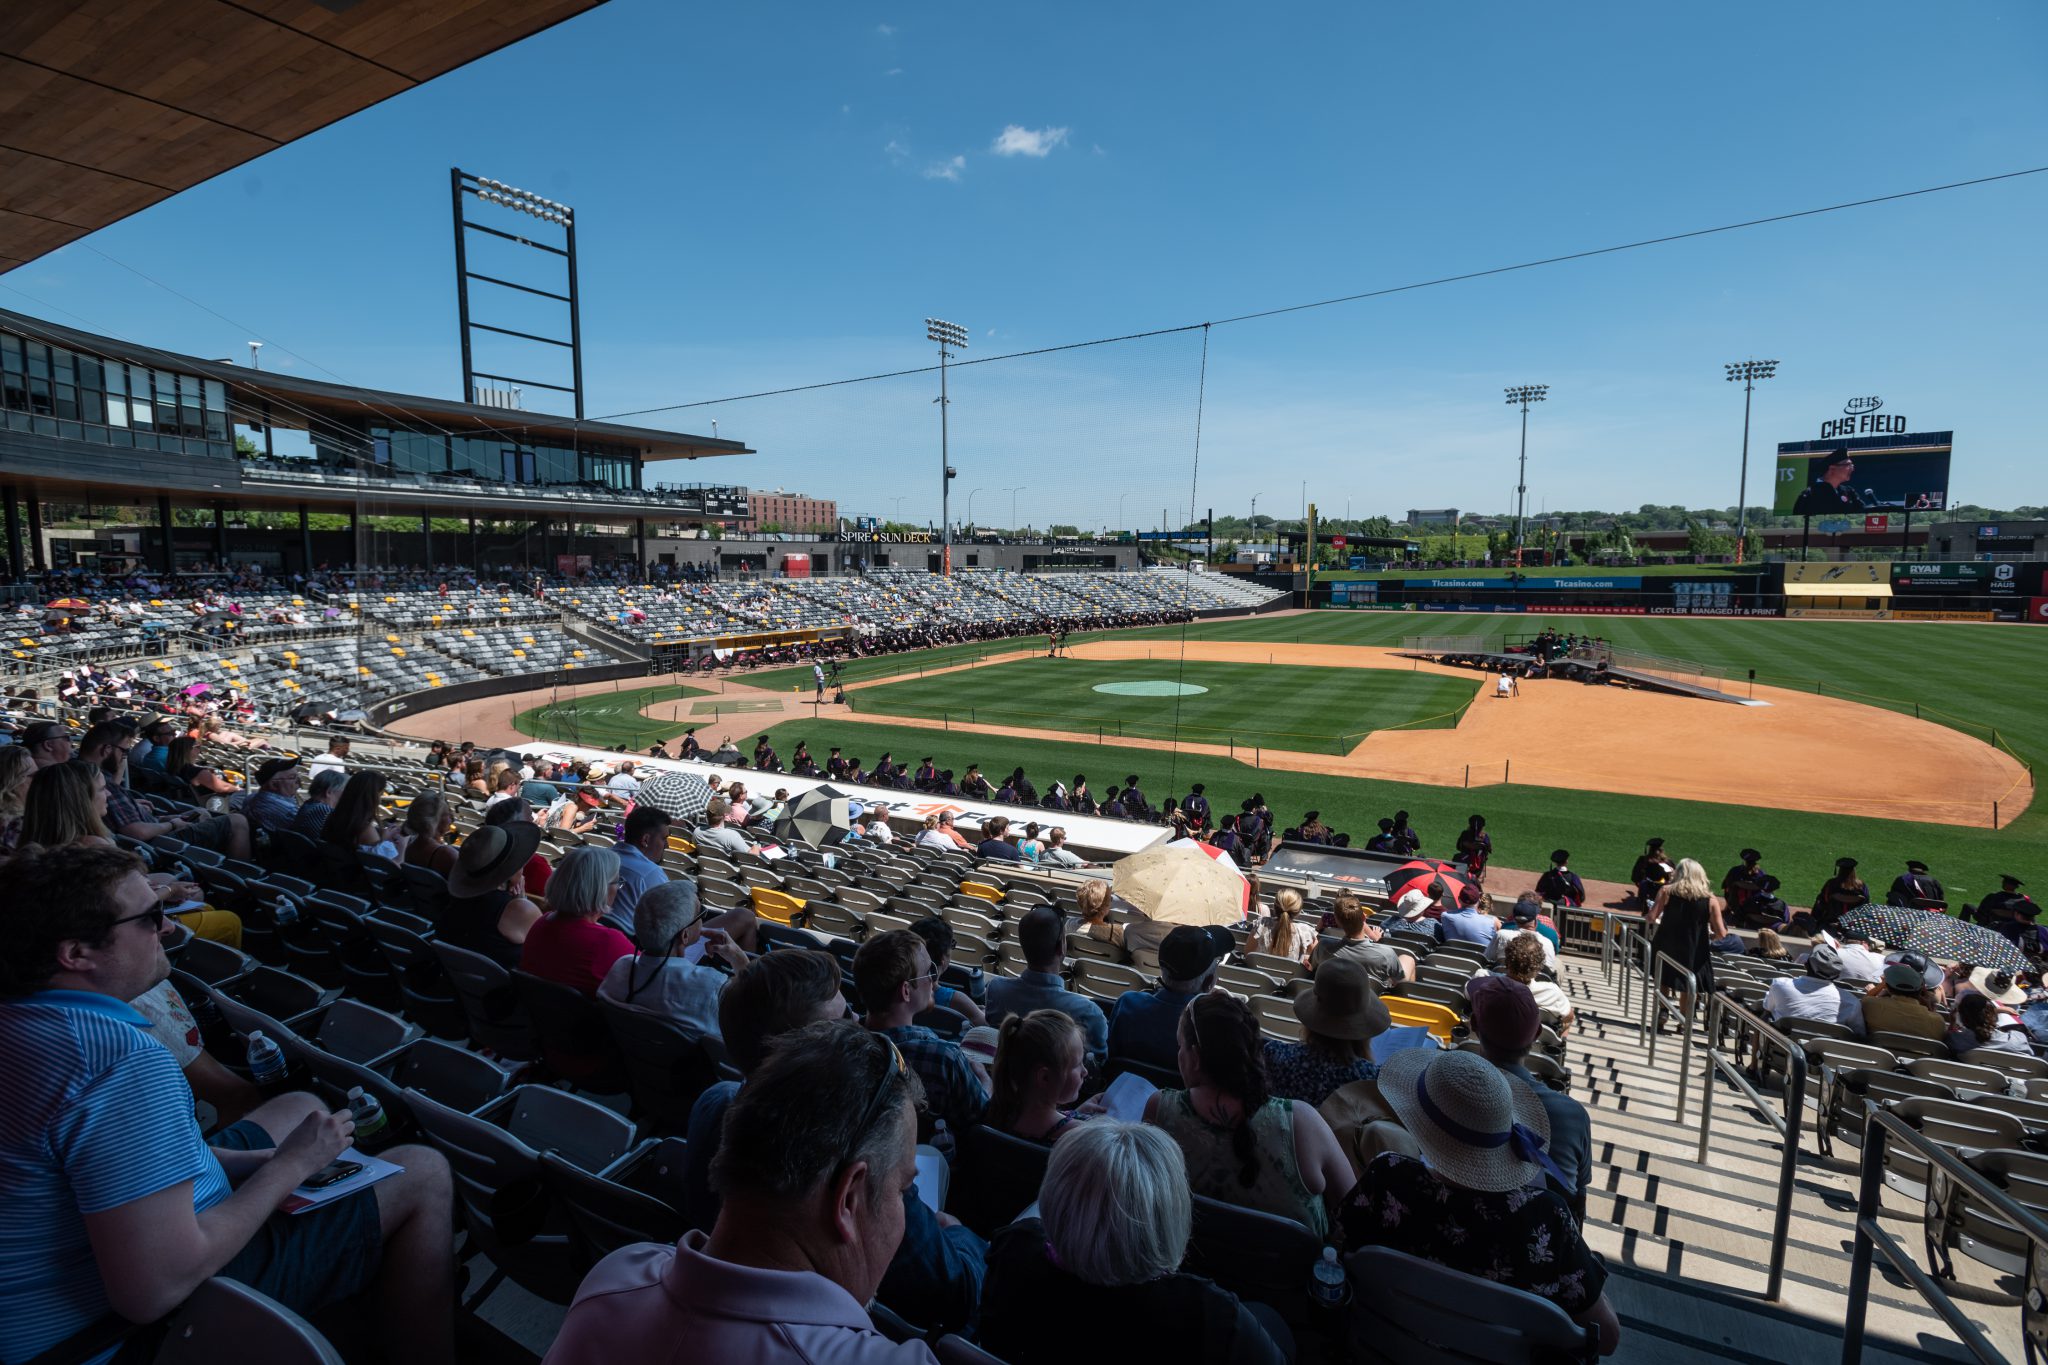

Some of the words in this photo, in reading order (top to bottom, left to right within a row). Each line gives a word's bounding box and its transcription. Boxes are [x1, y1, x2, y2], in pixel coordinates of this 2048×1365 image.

[1848, 396, 1880, 408] CHS
[1821, 416, 1856, 439] CHS
[1860, 415, 1906, 433] FIELD
[1776, 467, 1796, 482] TS
[841, 532, 871, 543] SPIRE
[880, 532, 901, 543] SUN
[903, 532, 931, 543] DECK
[1910, 565, 1941, 574] RYAN
